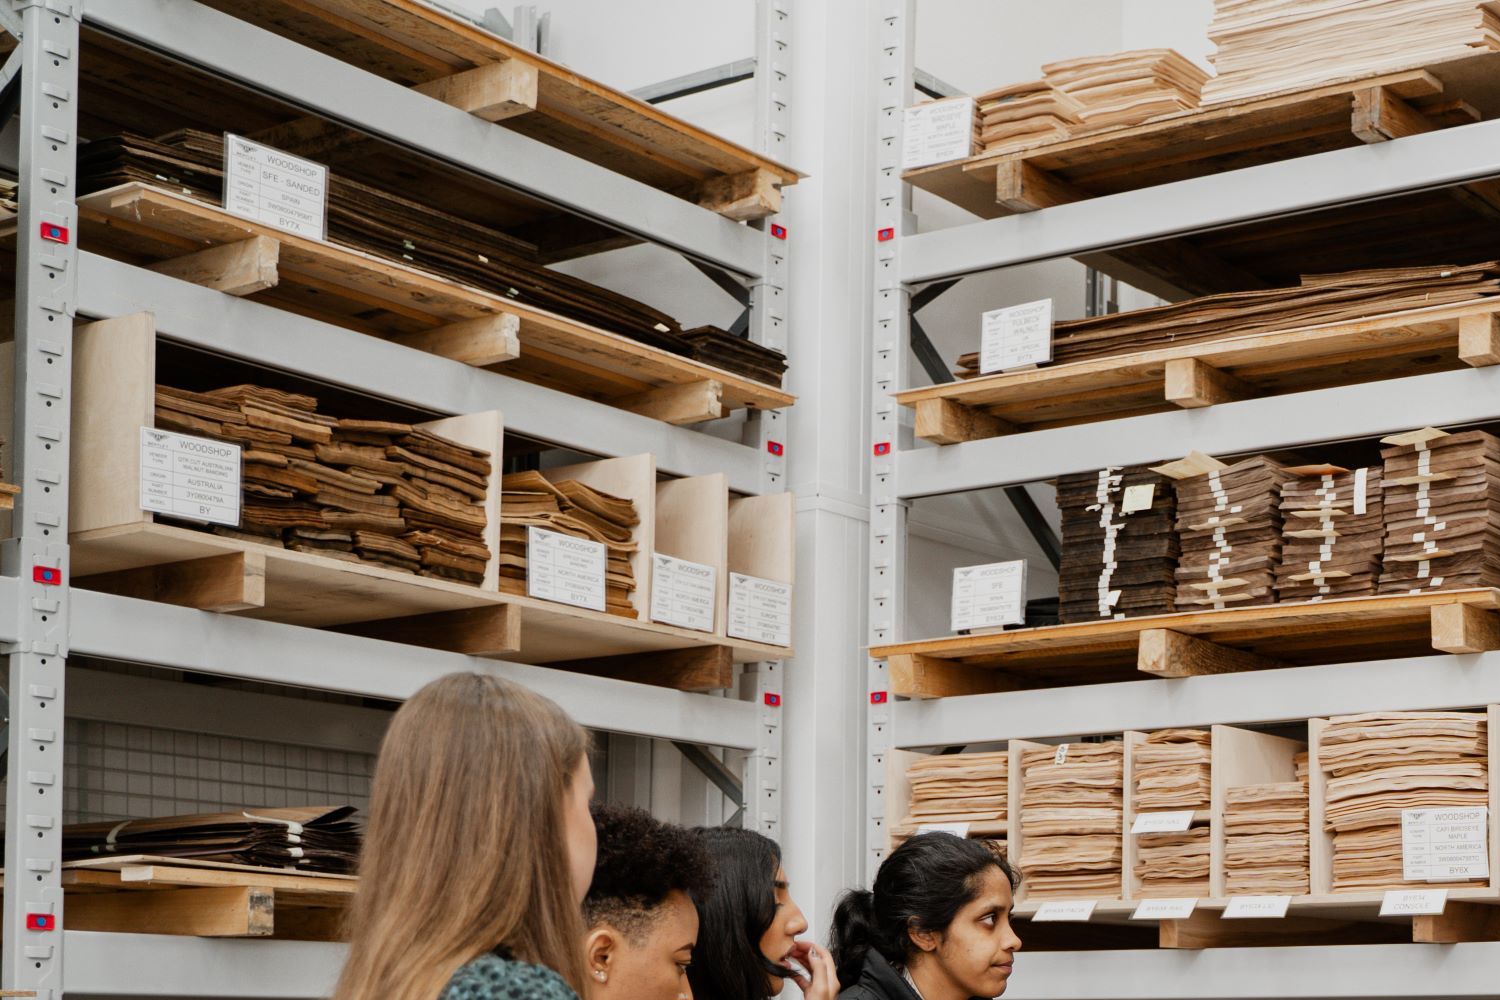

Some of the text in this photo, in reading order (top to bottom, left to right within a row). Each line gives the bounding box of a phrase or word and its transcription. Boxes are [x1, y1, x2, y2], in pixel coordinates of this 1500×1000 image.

[267, 155, 317, 177] WOODSHOP
[263, 171, 278, 182] SFE
[286, 179, 320, 196] SANDED
[180, 441, 232, 456] WOODSHOP
[188, 479, 223, 490] AUSTRALIA
[559, 540, 598, 553] WOODSHOP
[678, 565, 711, 576] WOODSHOP
[1435, 812, 1479, 820] WOODSHOP
